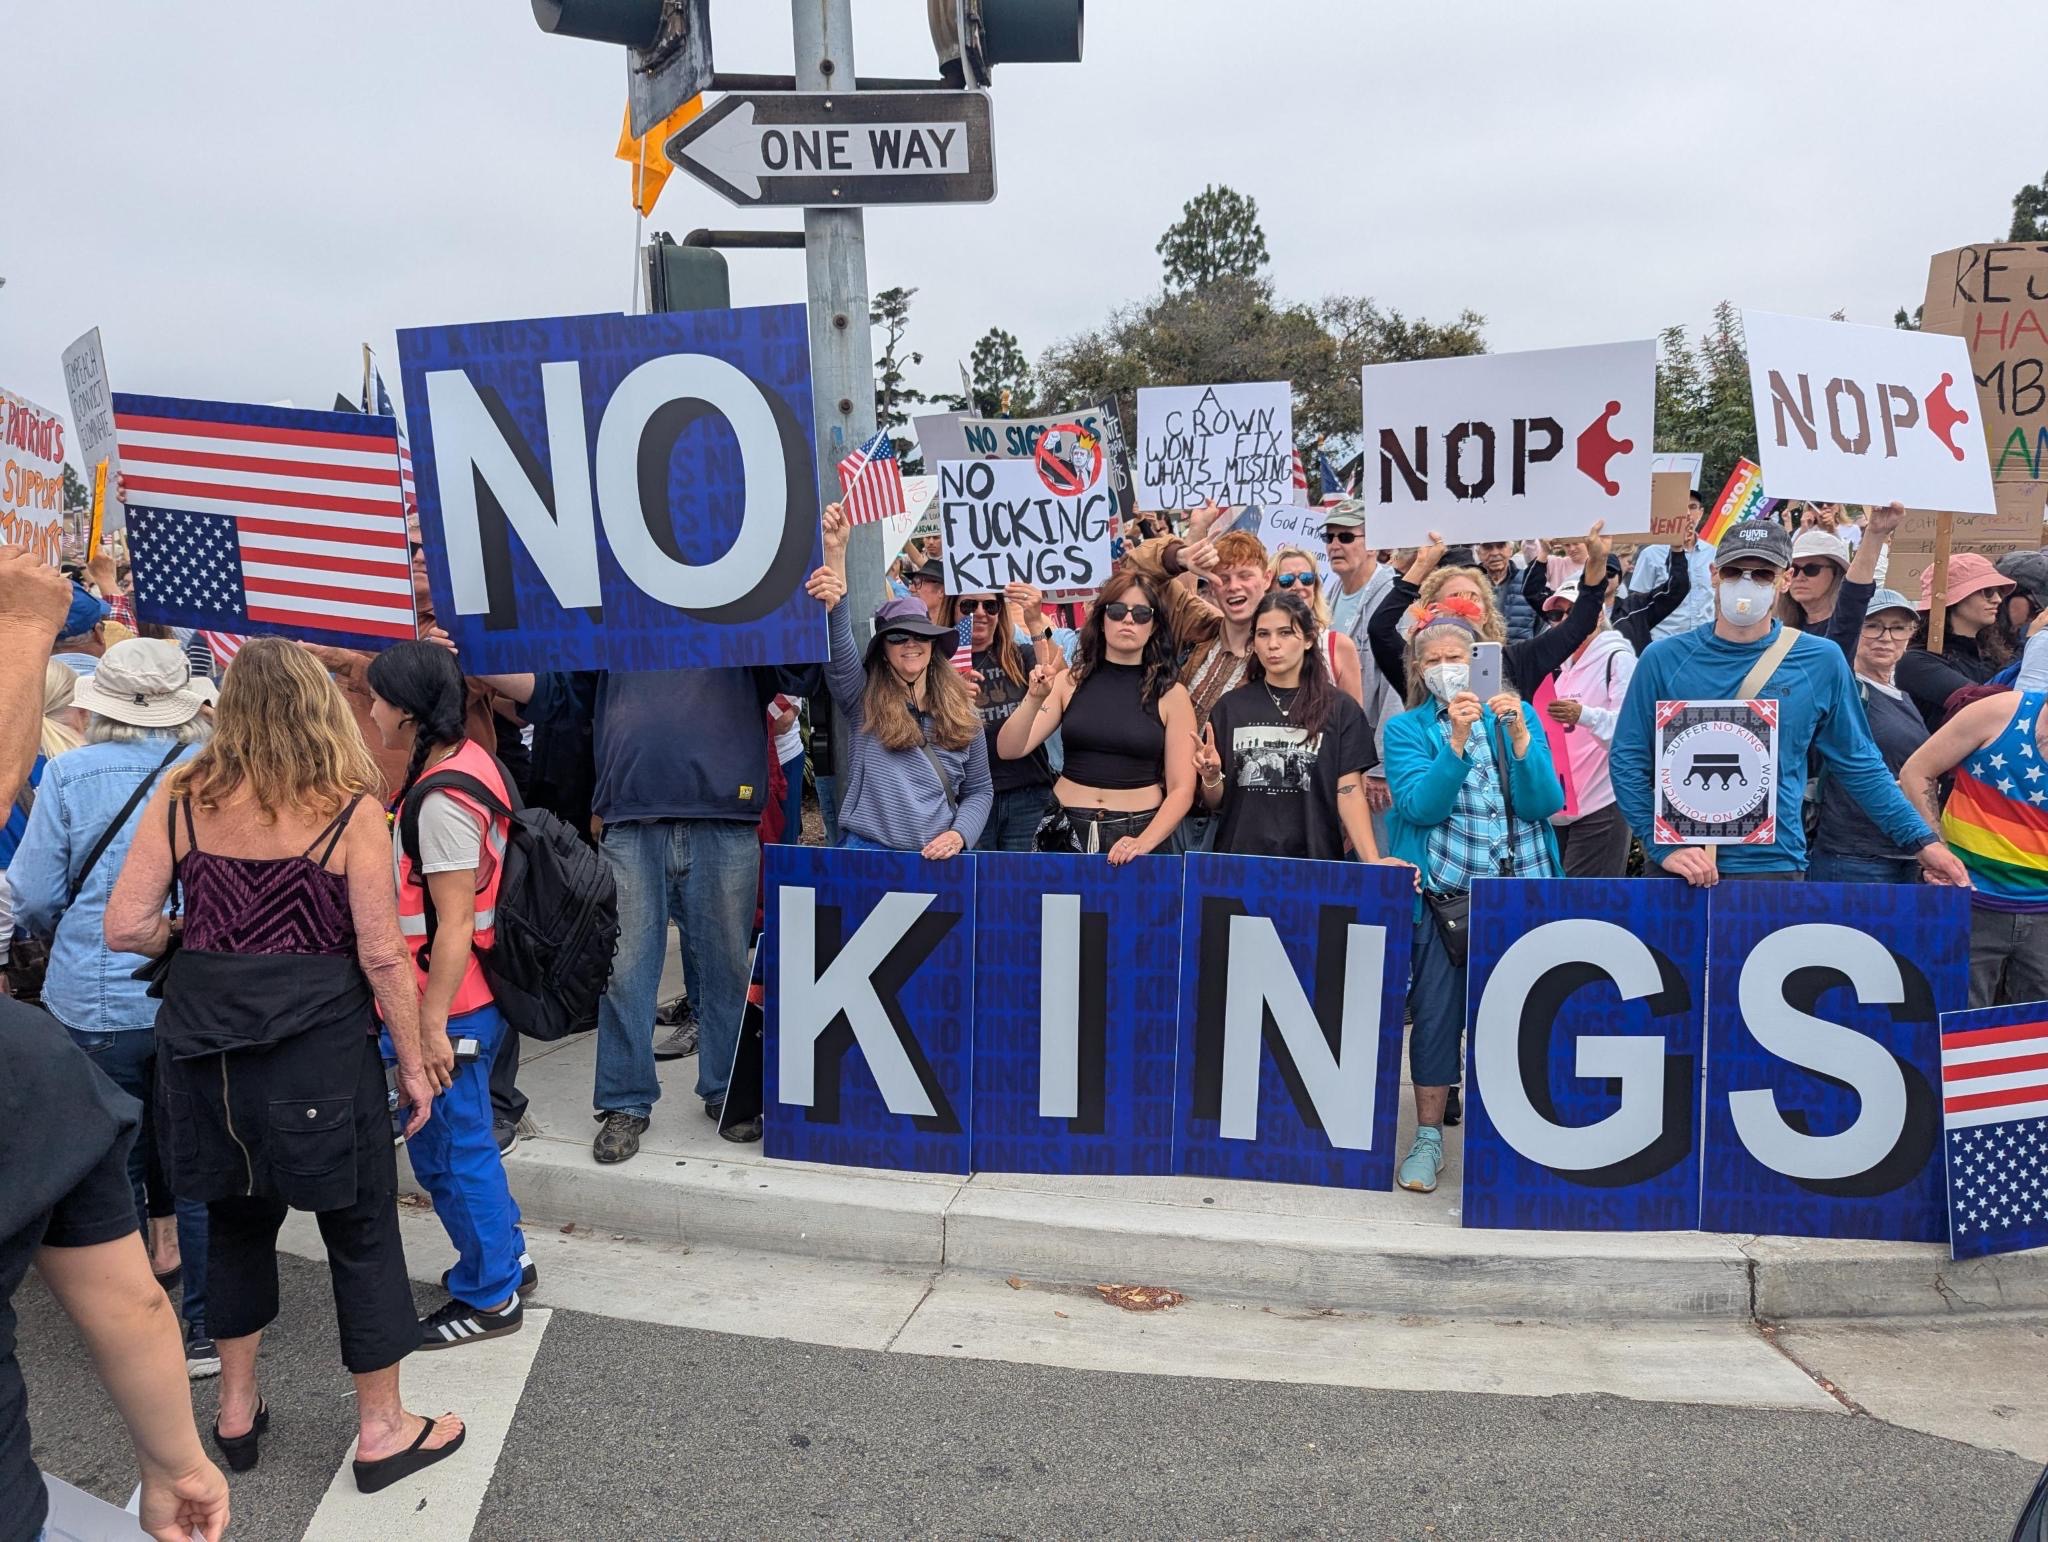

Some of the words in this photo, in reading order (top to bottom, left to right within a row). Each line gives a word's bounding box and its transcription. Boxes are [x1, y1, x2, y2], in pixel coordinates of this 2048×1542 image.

[761, 130, 852, 170] ONE
[869, 128, 956, 169] WAY
[1198, 386, 1223, 411] A
[1166, 407, 1275, 436] CROWN
[964, 425, 998, 454] NO
[1234, 430, 1282, 457] FIX
[425, 353, 787, 615] NO
[942, 462, 994, 500] NO
[1225, 454, 1293, 485] MISSING
[3, 459, 64, 514] SUPPORT
[1160, 480, 1282, 510] UPSTAIRS
[943, 499, 1110, 551] FUCKING
[1271, 510, 1298, 530] God
[949, 545, 1094, 594] KINGS
[1667, 723, 1709, 756] SUFFER
[1713, 723, 1733, 732] NO
[1736, 728, 1764, 753] KING
[1661, 768, 1708, 822] POLITICIAN
[1737, 763, 1771, 817] WORSHIP
[1713, 812, 1733, 822] NO
